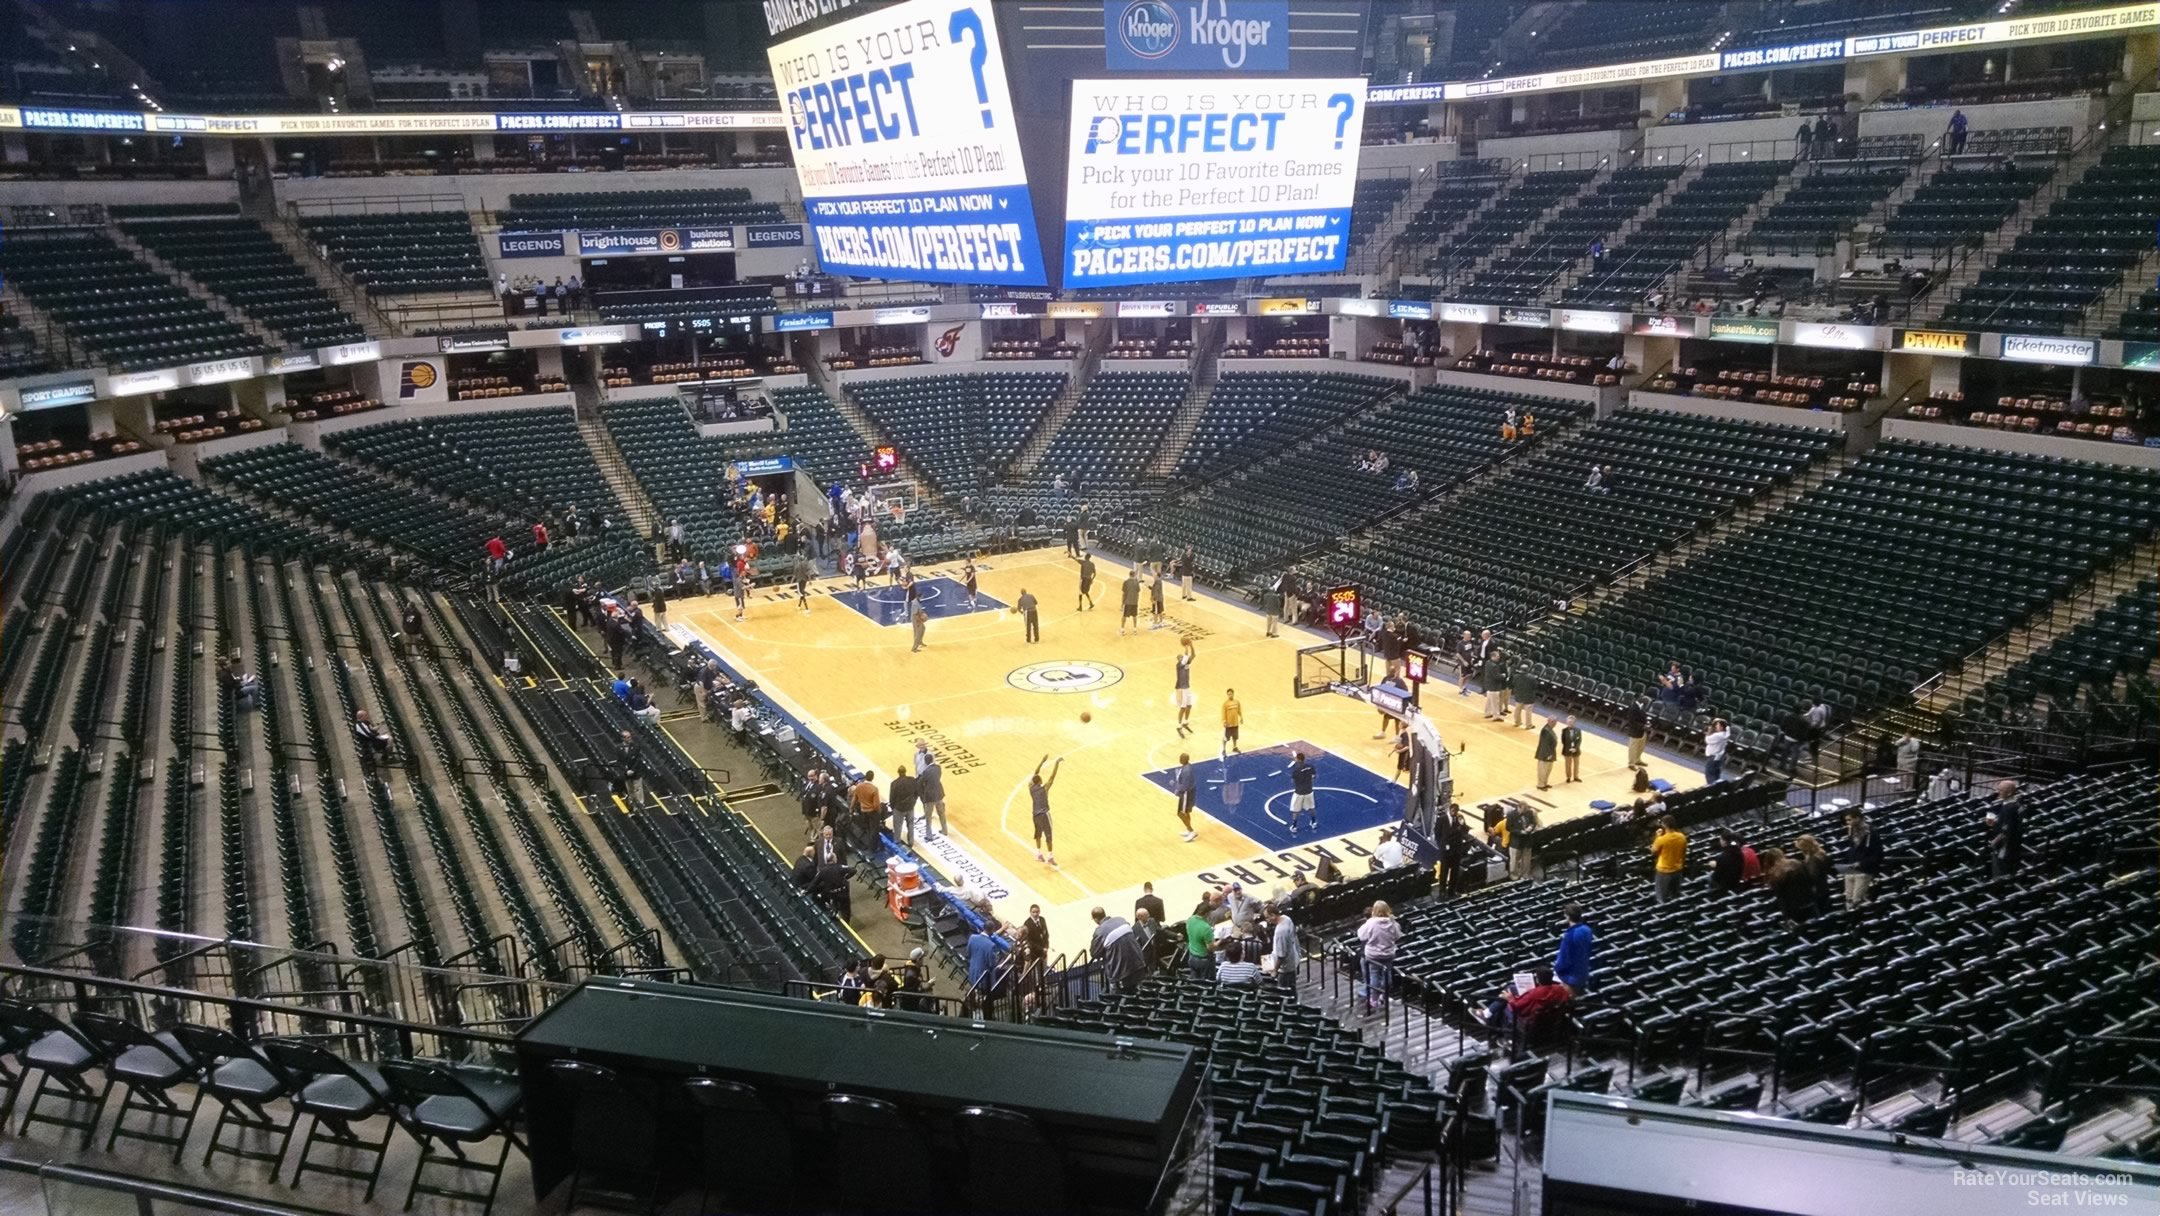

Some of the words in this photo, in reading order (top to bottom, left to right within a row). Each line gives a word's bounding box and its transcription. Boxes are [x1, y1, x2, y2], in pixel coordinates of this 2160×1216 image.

[1128, 8, 1174, 49] Kroger
[2009, 23, 2029, 36] PICK
[2032, 21, 2056, 34] YOUR
[2058, 19, 2068, 31] 10
[2070, 14, 2117, 29] FAVORITE
[2120, 9, 2155, 25] GAMES
[1191, 0, 1271, 68] Kroger
[1923, 27, 1986, 44] PERFECT
[780, 53, 819, 86] WHO
[826, 44, 849, 74] IS
[857, 20, 940, 64] YOUR
[1724, 41, 1843, 68] PACERS.COM/PERFECT
[1856, 40, 1877, 53] WHO
[1555, 75, 1568, 84] PICK
[1591, 70, 1616, 80] FAVORITE
[1617, 68, 1636, 77] GAMES
[1639, 66, 1649, 75] FOR
[1651, 65, 1662, 74] THE
[1663, 62, 1688, 73] PERFECT
[1699, 59, 1714, 69] PLAN
[1506, 77, 1542, 90] PERFECT
[1093, 96, 1168, 111] WHO
[1186, 95, 1215, 111] IS
[1232, 94, 1317, 110] YOUR
[1366, 87, 1442, 102] .COM/PERFECT
[788, 62, 920, 150] PERFECT
[0, 113, 14, 123] LAN
[25, 111, 143, 128] PACERS.COM/PERFECT
[208, 120, 258, 130] PERFECT
[281, 121, 297, 129] PICK
[300, 121, 319, 129] YOUR
[332, 119, 367, 129] FAVORITE
[370, 119, 395, 128] GAMES
[398, 119, 411, 128] FOR
[414, 119, 427, 128] THE
[430, 118, 460, 127] PERFECT
[472, 118, 490, 127] PLAN
[500, 115, 619, 128] PACERS.COM/PERFECT
[688, 116, 735, 125] PERFECT
[1327, 93, 1354, 150] ?
[1084, 112, 1285, 154] PERFECT
[919, 150, 960, 177] Perfect
[958, 147, 974, 174] 10
[1083, 166, 1124, 184] Pick
[1131, 168, 1174, 186] your
[1179, 164, 1200, 181] 10
[1206, 161, 1279, 180] Favorite
[1284, 160, 1342, 178] Games
[1110, 190, 1138, 208] for
[1142, 190, 1173, 206] the
[1180, 186, 1245, 206] Perfect
[1251, 186, 1269, 203] 10
[1276, 184, 1319, 201] Plan!
[818, 201, 838, 216] PICK
[838, 200, 860, 215] YOUR
[861, 198, 906, 214] PERFECT
[908, 198, 923, 212] 10
[925, 196, 958, 212] PLAN
[960, 195, 992, 211] NOW
[690, 230, 729, 239] business
[749, 231, 801, 242] LEGENDS
[1094, 225, 1131, 240] PICK
[1135, 223, 1173, 238] YOUR
[1176, 220, 1236, 237] PERFECT
[1239, 219, 1255, 234] 10
[1259, 217, 1293, 232] PLAN
[1296, 215, 1326, 231] NOW
[502, 238, 562, 252] LEGENDS
[582, 236, 619, 249] bright
[620, 235, 657, 246] house
[691, 239, 731, 248] solutions
[816, 223, 1024, 271] PACERS.COM/PERFECT
[1073, 235, 1339, 276] PACERS.COM/PERFECT
[1307, 301, 1320, 310] CAT
[1711, 322, 1778, 336] bankerslife.com
[2007, 338, 2092, 356] ticketmaster
[22, 391, 50, 403] SPORT
[52, 385, 95, 399] GRAPHICS
[1334, 602, 1355, 622] 24
[884, 720, 915, 736] LIFE
[908, 720, 986, 767] FIELDHOUSE
[1401, 837, 1419, 852] STATE
[1197, 838, 1374, 890] PACERS
